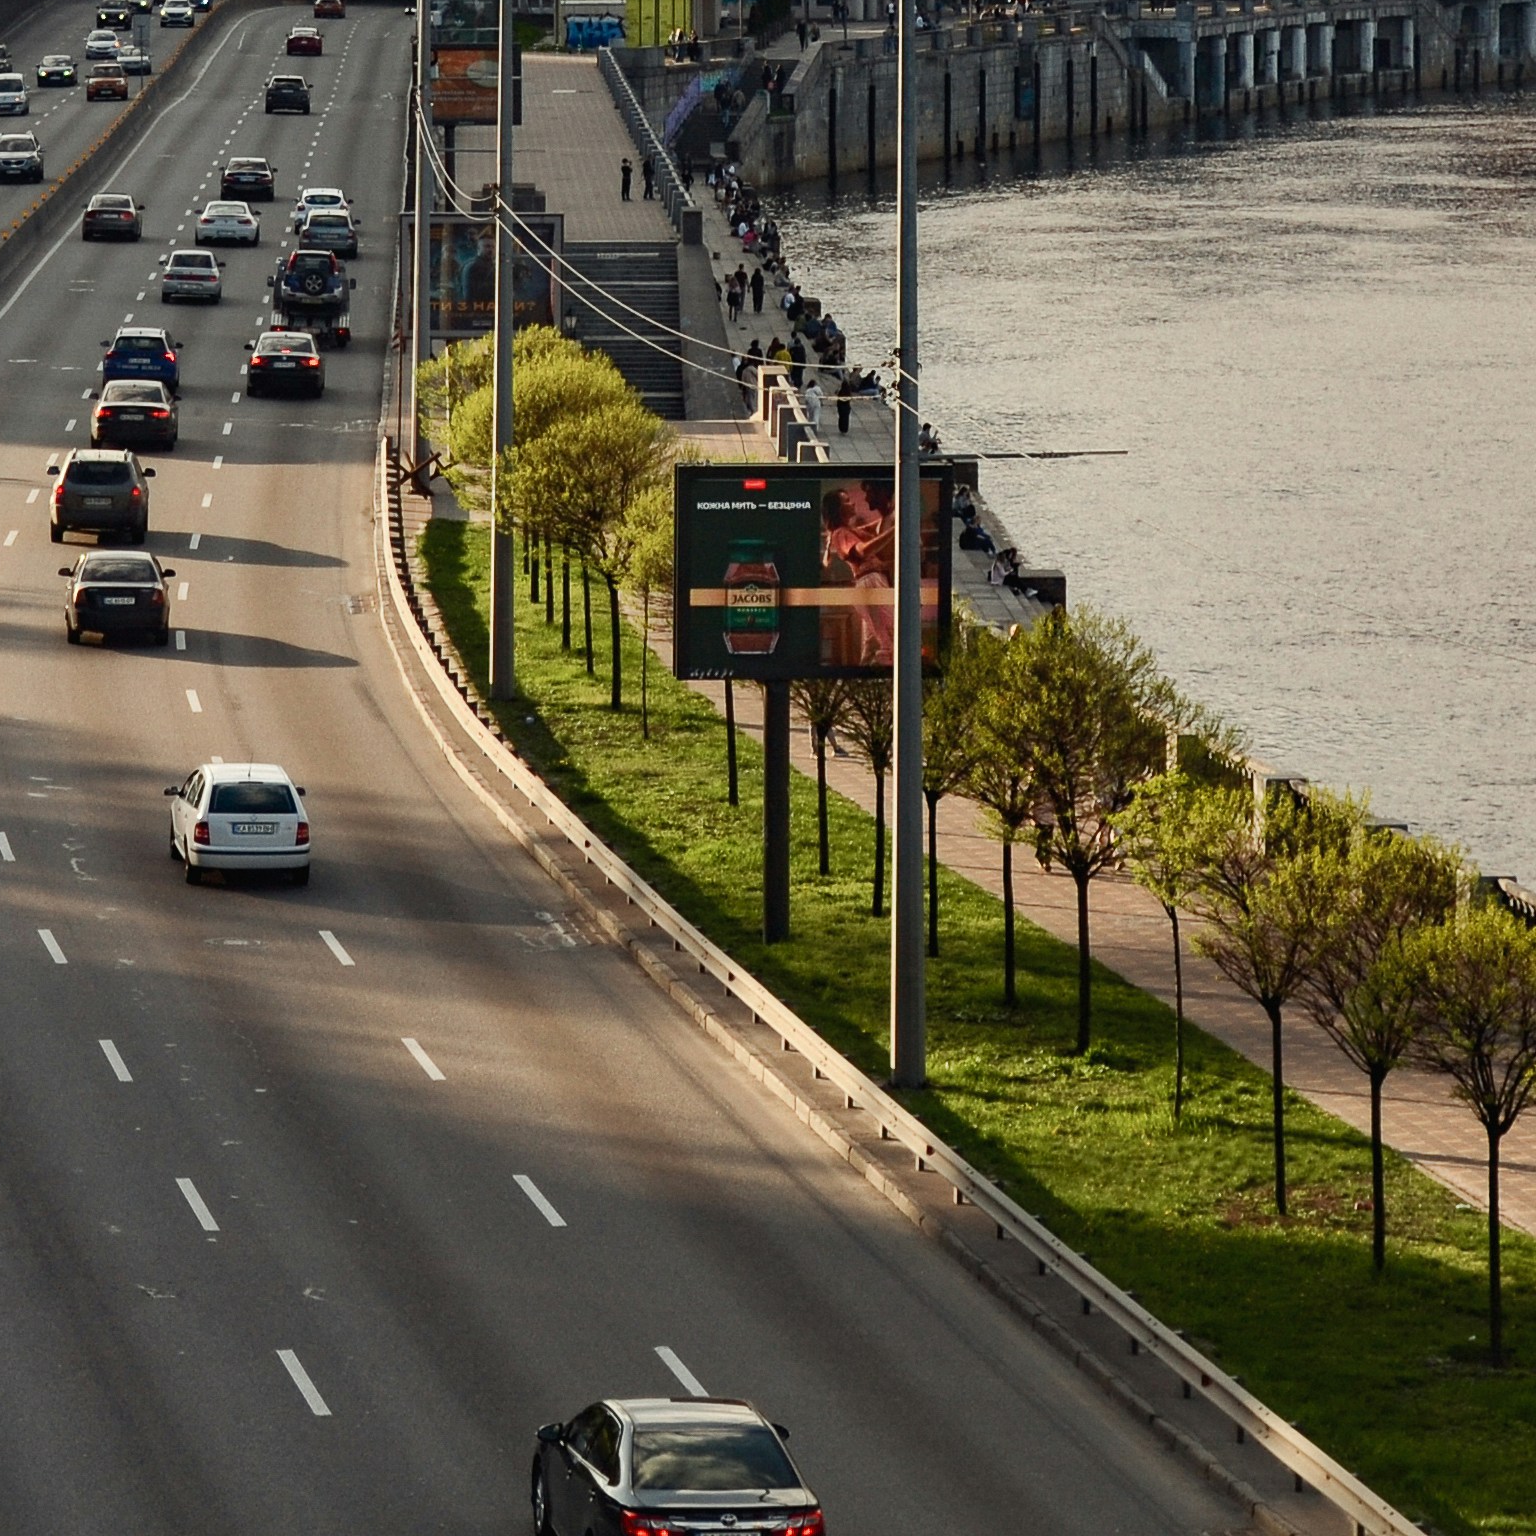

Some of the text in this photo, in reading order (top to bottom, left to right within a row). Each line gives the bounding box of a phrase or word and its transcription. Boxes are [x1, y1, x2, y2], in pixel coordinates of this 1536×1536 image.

[473, 300, 537, 311] НАИ?
[697, 501, 730, 511] КОЖНА
[731, 501, 757, 511] МИТЬ
[731, 594, 772, 604] JACOBS
